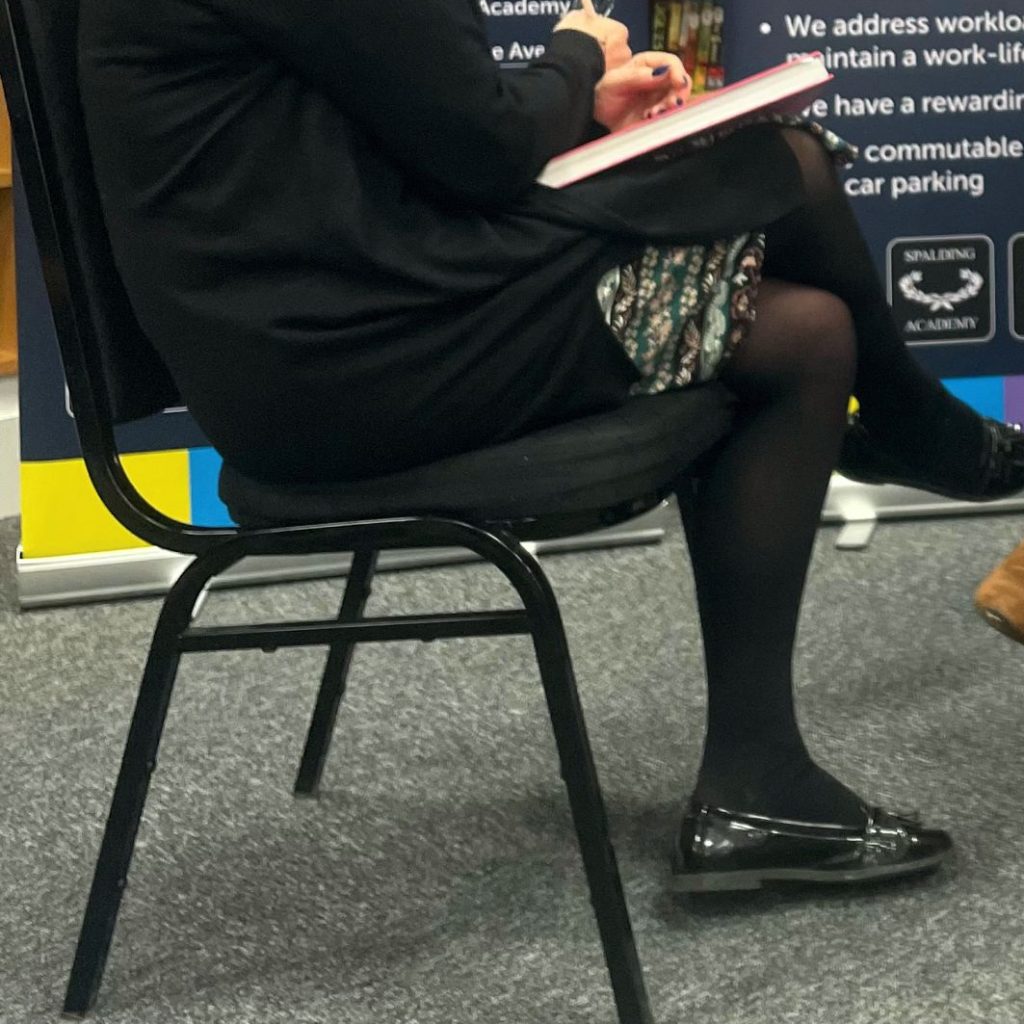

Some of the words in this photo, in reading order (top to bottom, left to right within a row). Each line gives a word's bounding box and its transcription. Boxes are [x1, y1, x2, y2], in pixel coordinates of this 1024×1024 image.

[785, 14, 827, 38] We
[832, 13, 930, 37] address
[787, 44, 896, 69] intain
[902, 49, 917, 67] a
[834, 93, 895, 116] have
[900, 96, 915, 114] a
[864, 136, 1024, 163] commutable
[844, 177, 886, 196] car
[891, 169, 984, 199] parking
